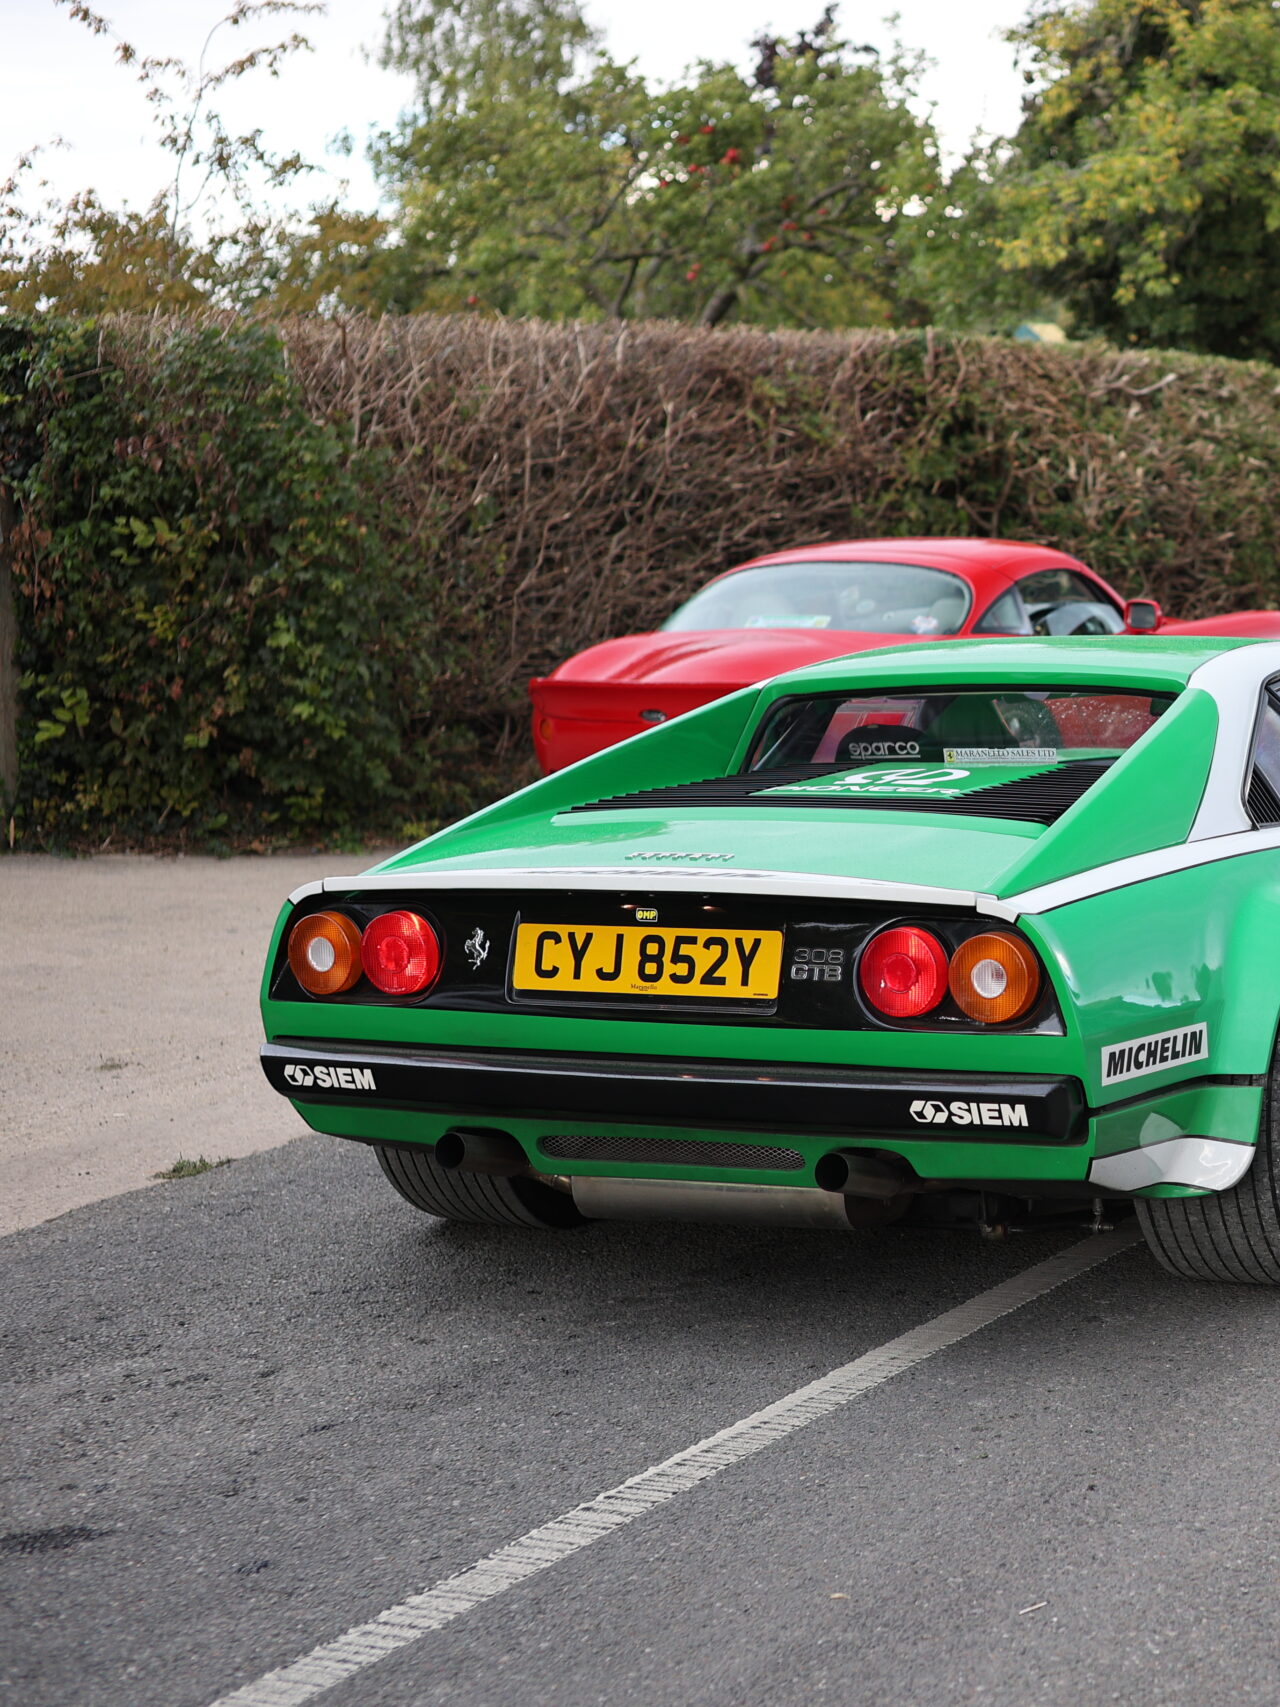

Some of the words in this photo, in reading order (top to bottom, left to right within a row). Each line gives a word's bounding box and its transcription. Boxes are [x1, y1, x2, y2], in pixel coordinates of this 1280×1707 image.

[849, 741, 920, 760] sparco
[955, 749, 1009, 758] MARANELLO
[1011, 749, 1036, 758] SALES
[1037, 749, 1054, 758] LTD
[763, 785, 961, 795] PIONEER
[637, 910, 657, 920] OMP
[534, 930, 624, 982] CYJ
[637, 934, 762, 987] 852Y
[794, 948, 844, 964] 308
[790, 964, 842, 981] GTB
[1106, 1029, 1203, 1079] MICHELIN
[313, 1065, 377, 1091] SIEM
[949, 1101, 1029, 1127] SIEM
